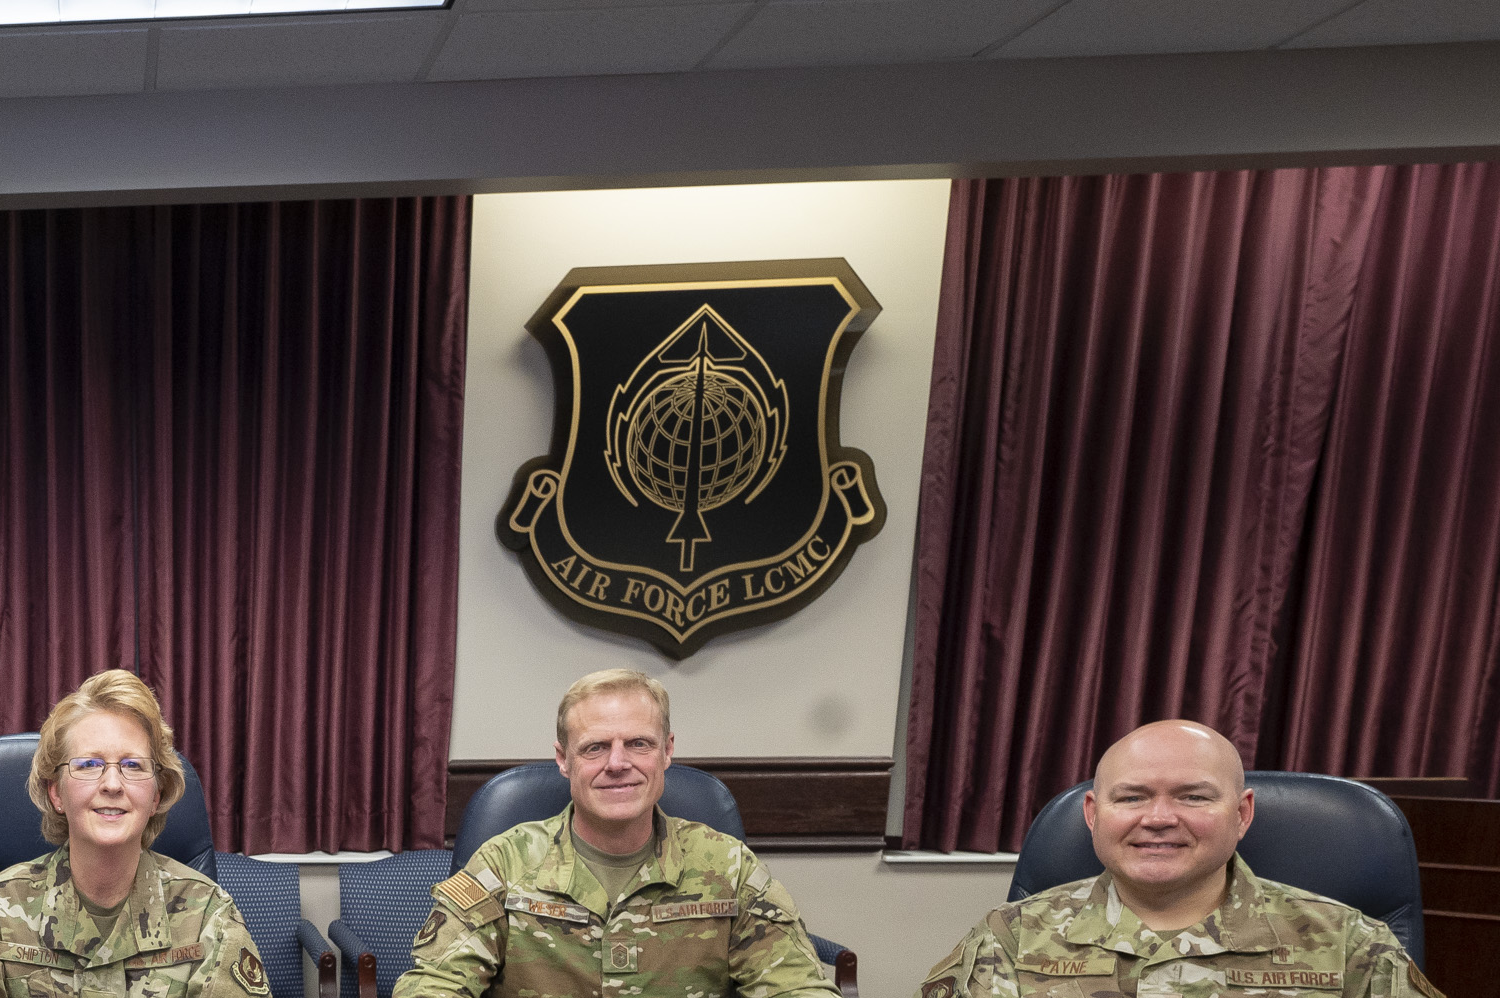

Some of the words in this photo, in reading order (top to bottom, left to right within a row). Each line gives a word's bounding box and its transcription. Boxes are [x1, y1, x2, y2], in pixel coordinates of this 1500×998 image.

[550, 554, 612, 600] AIR
[620, 577, 731, 627] FORCE
[741, 534, 831, 600] LCMC
[678, 903, 698, 916] AIR
[699, 901, 735, 915] FORCE
[15, 946, 60, 965] SHIPTON
[1040, 959, 1088, 974] PAYNE
[1262, 971, 1287, 985] AIR
[1290, 971, 1339, 986] FORCE
